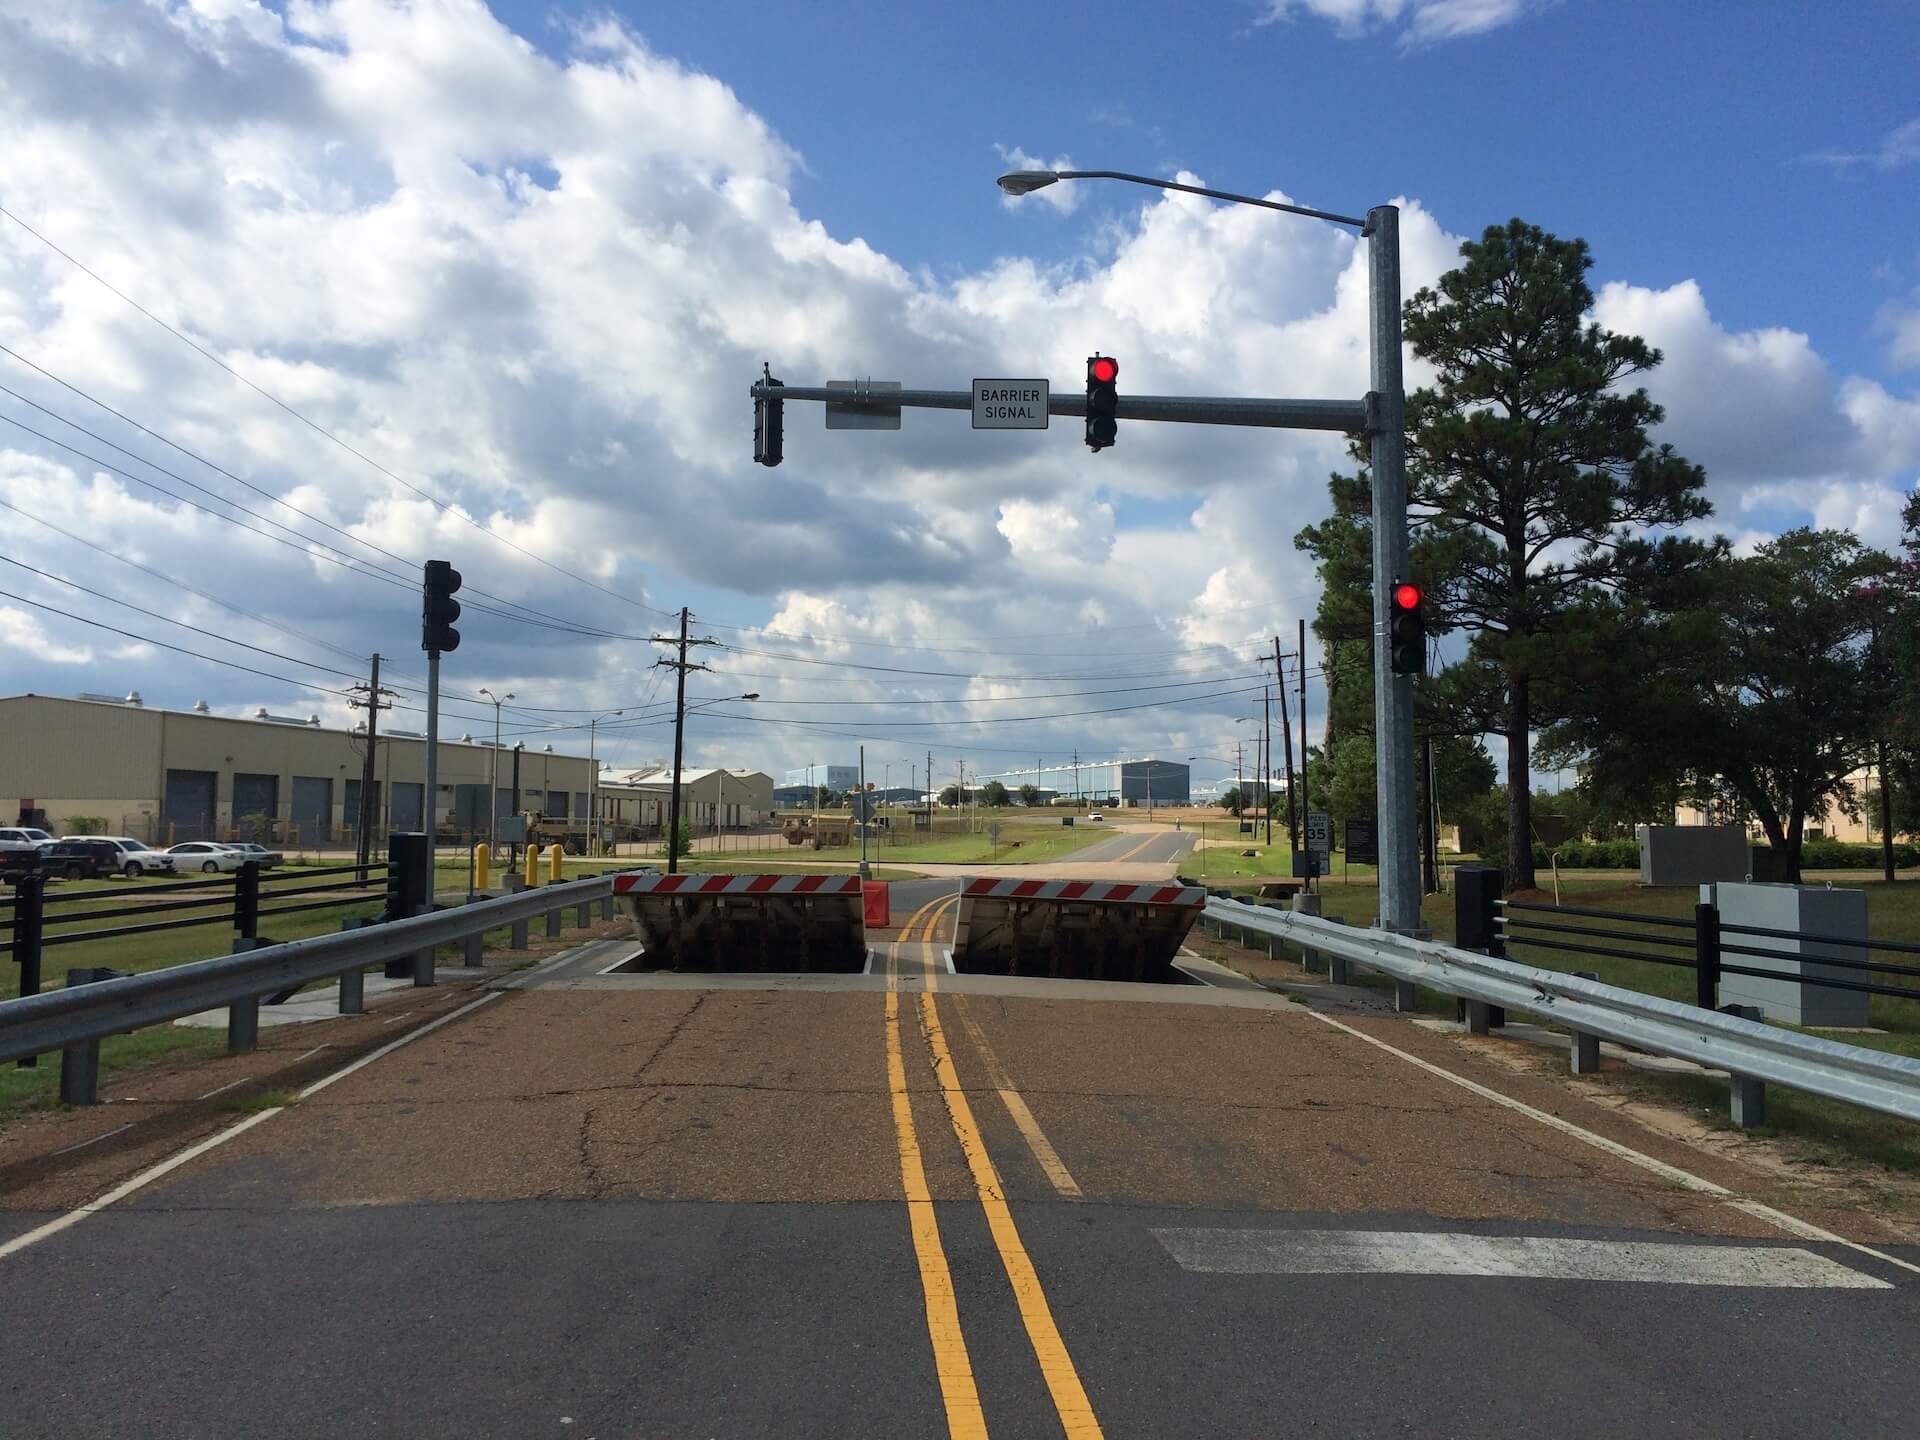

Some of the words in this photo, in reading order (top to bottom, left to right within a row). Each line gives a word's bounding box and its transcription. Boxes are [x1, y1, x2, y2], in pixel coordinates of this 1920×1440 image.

[981, 389, 1040, 402] BARRIER
[985, 406, 1036, 419] SIGNAL
[1307, 828, 1326, 840] 35
